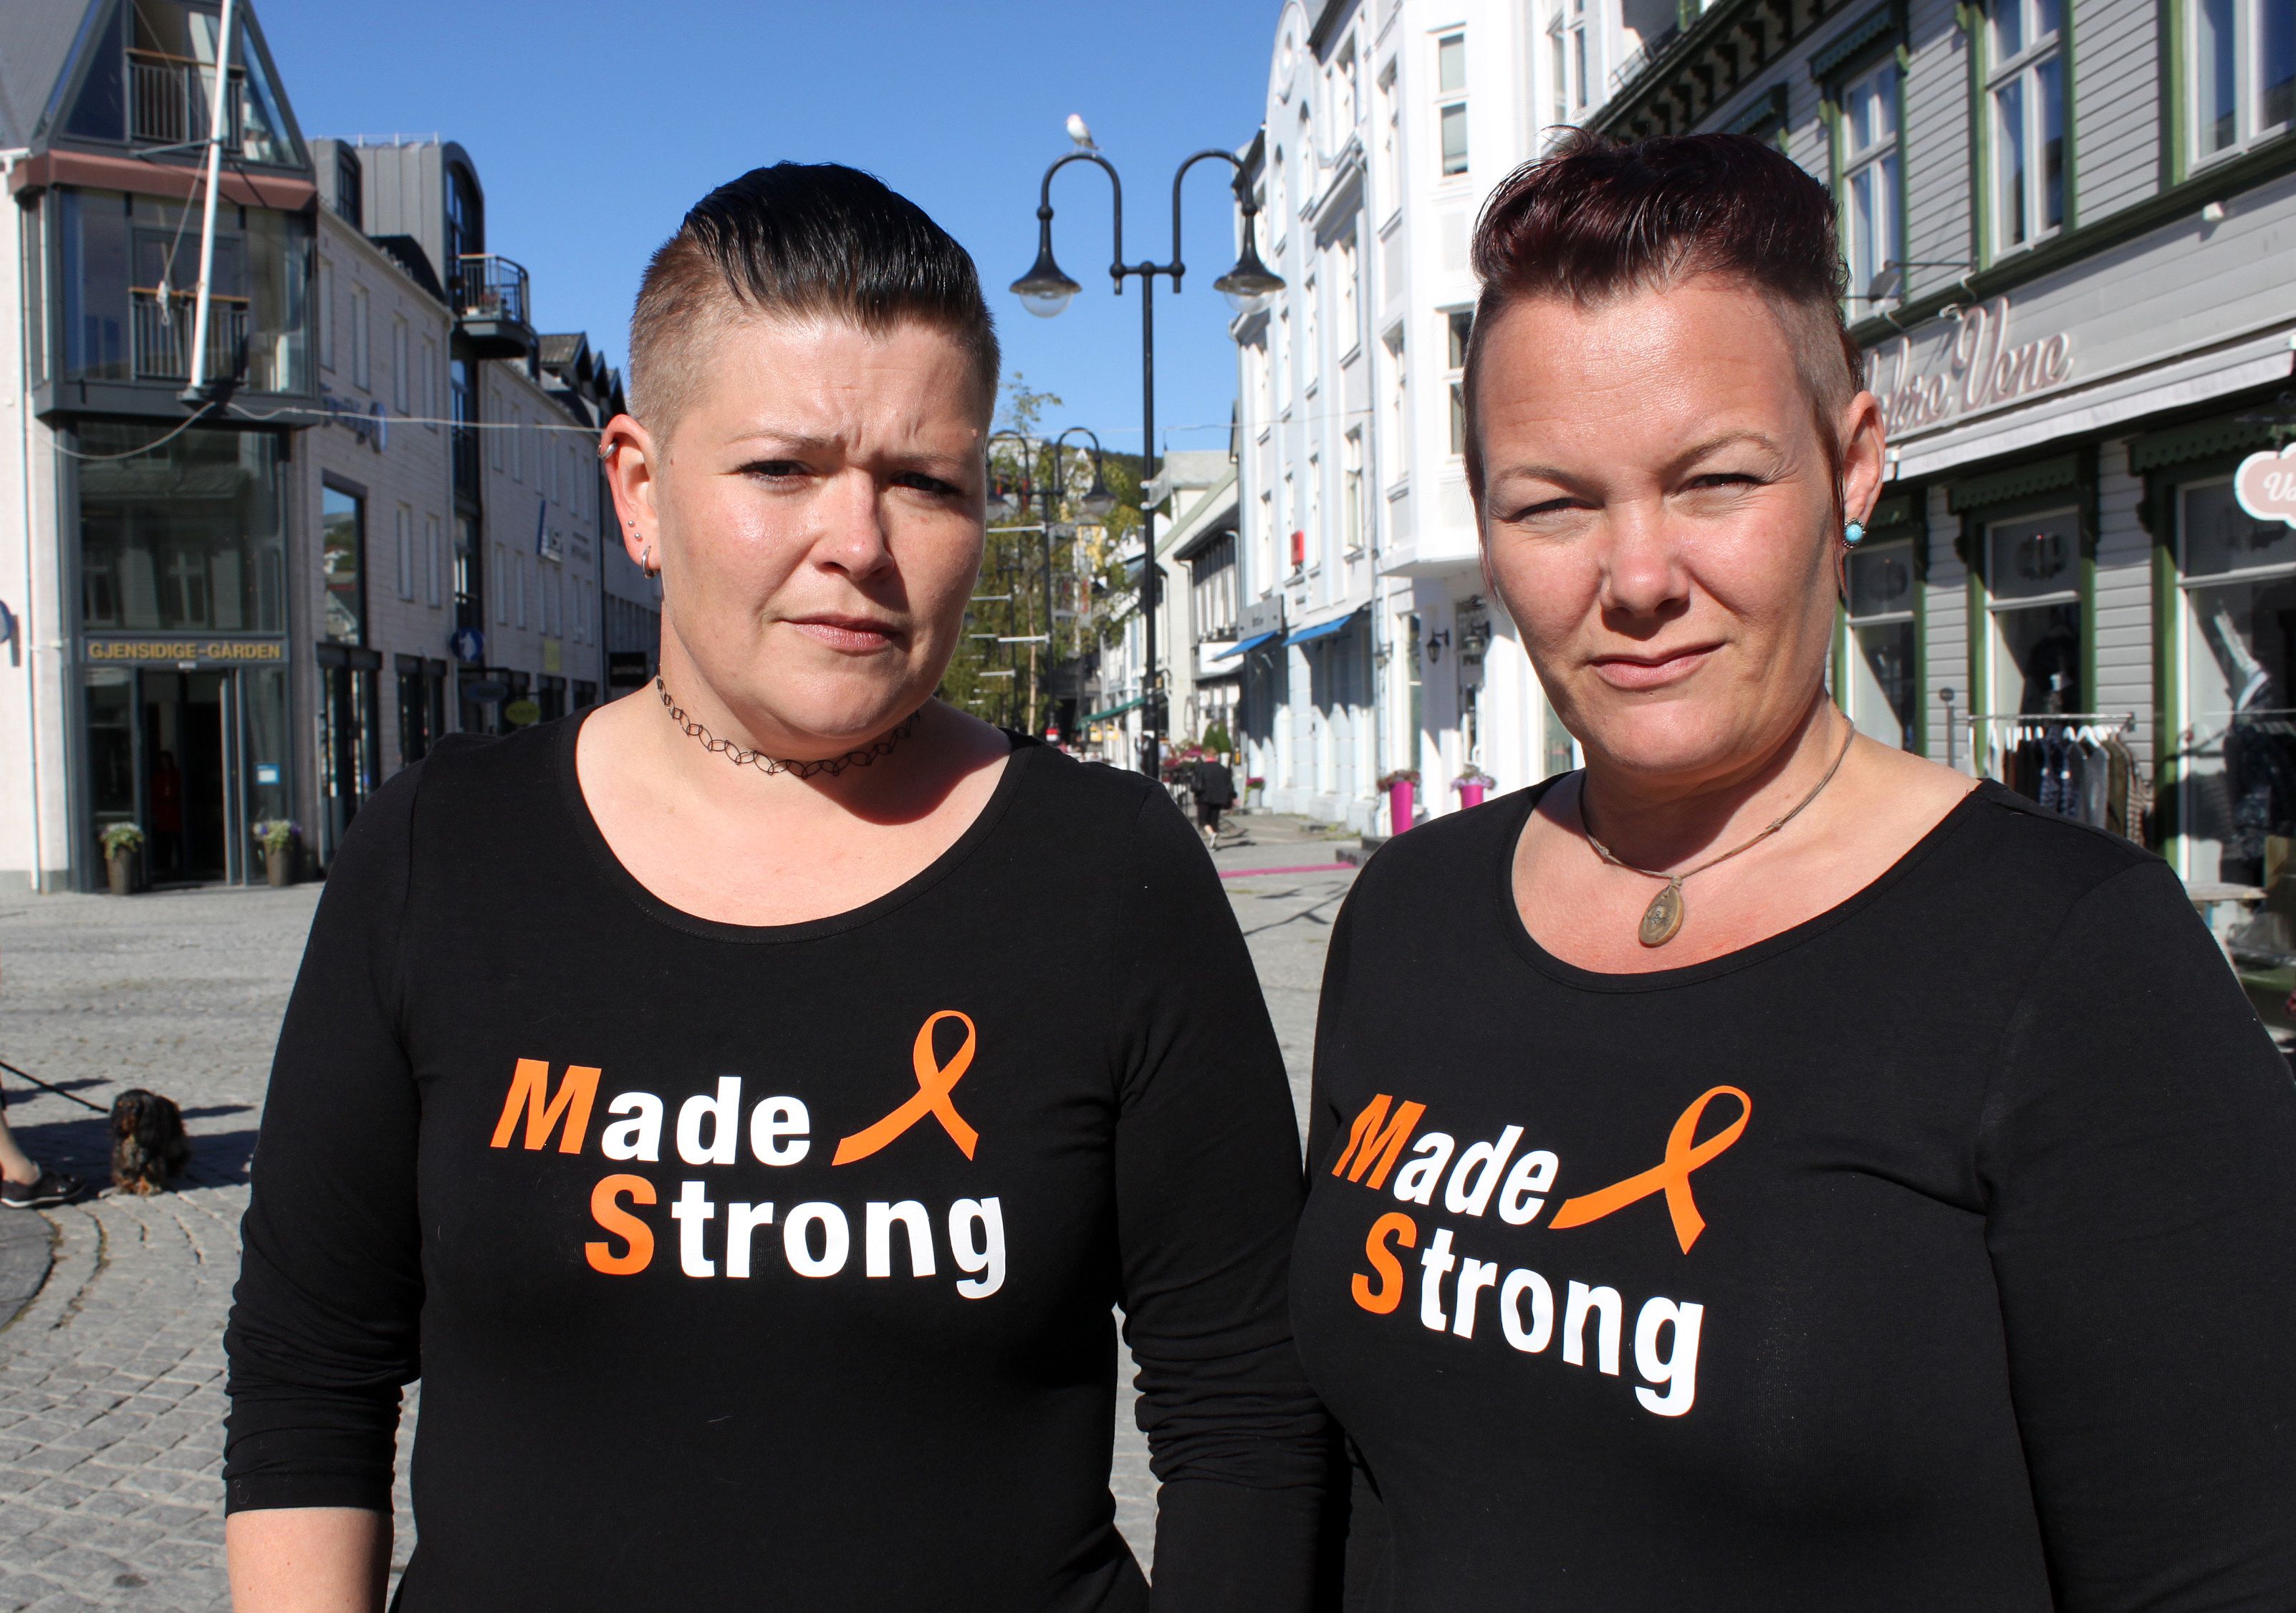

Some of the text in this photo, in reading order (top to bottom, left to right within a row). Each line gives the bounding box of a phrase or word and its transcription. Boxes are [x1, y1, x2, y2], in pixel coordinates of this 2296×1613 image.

[1952, 296, 2075, 413] Vene
[88, 640, 281, 660] GJENSIDIGE-GÅRDEN
[490, 1058, 810, 1167] Made
[1332, 1094, 1559, 1225] Made
[585, 1174, 1006, 1299] Strong
[1352, 1213, 1704, 1417] Strong
